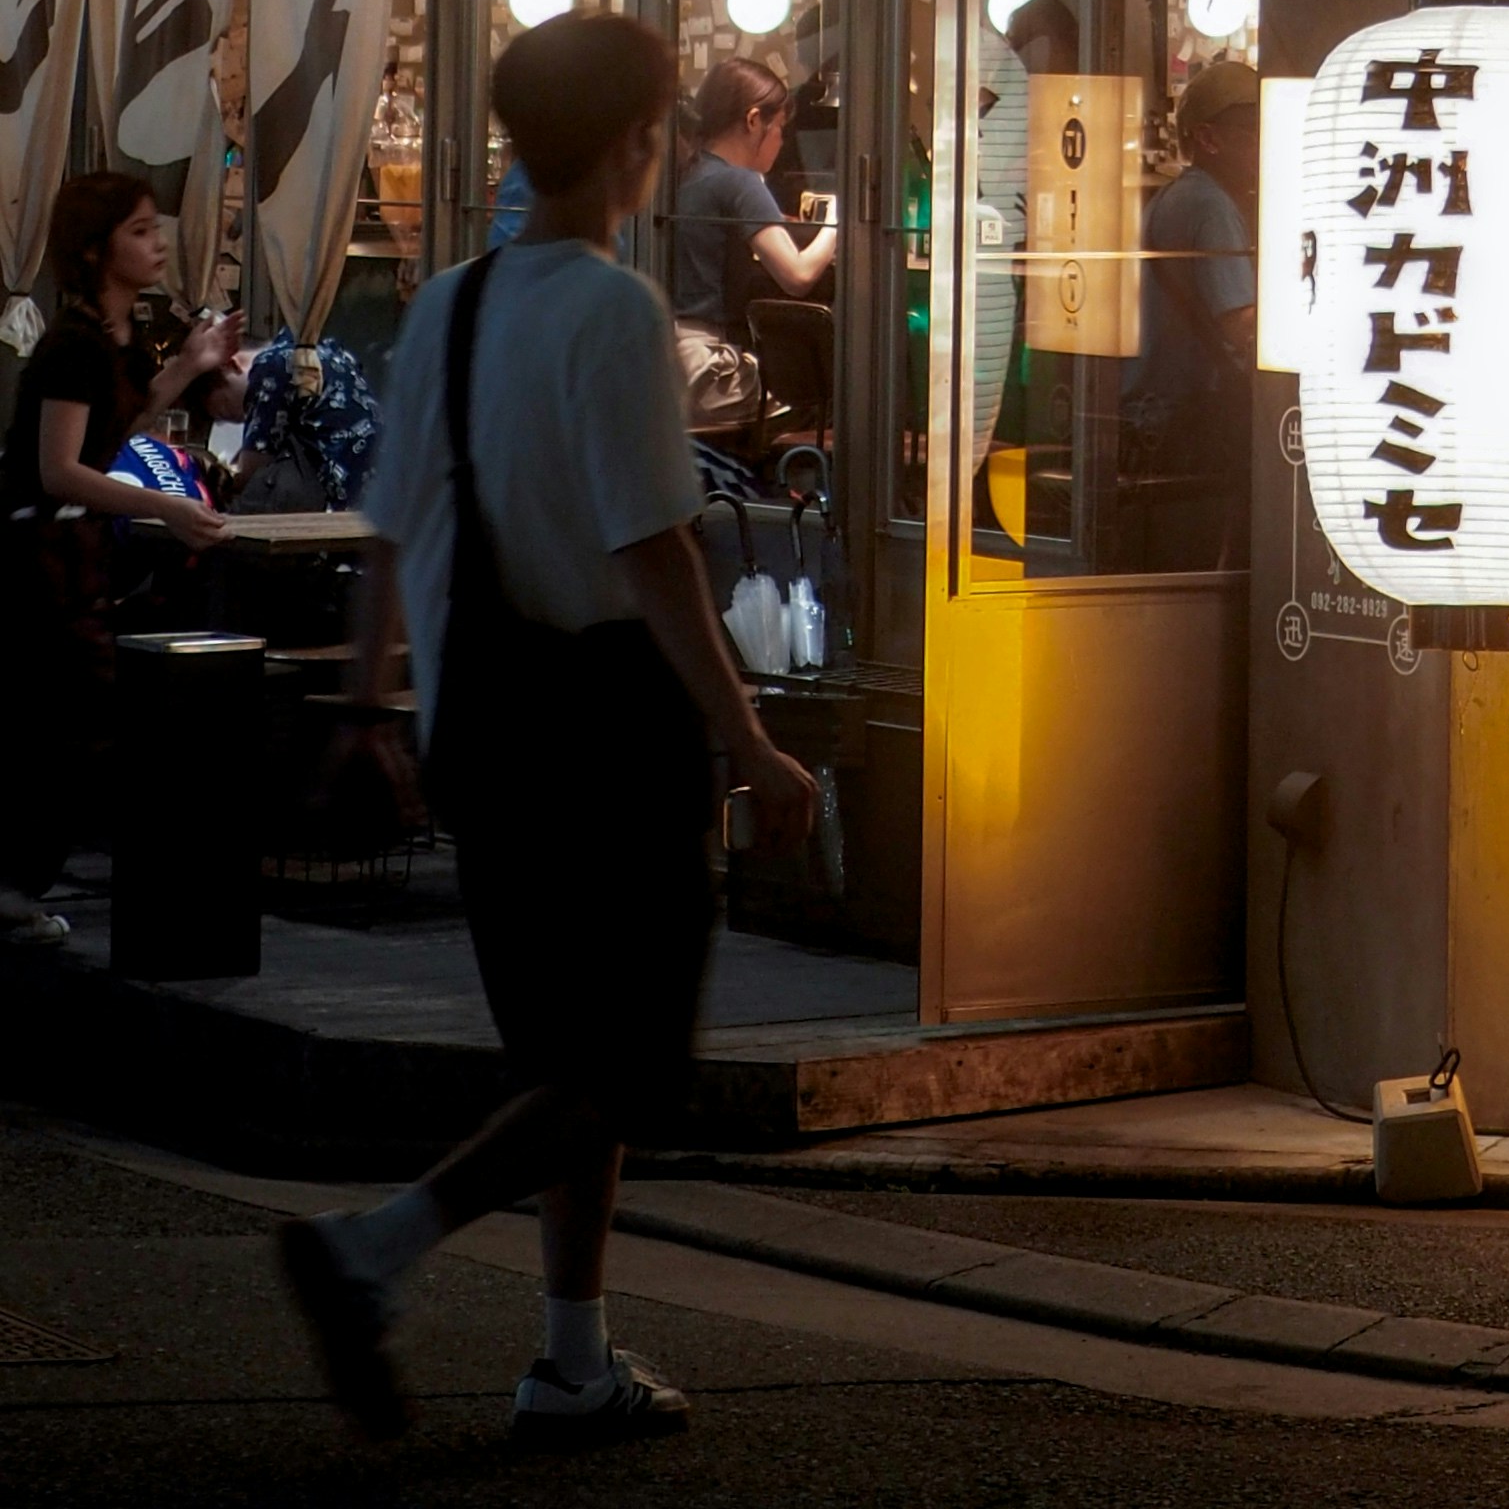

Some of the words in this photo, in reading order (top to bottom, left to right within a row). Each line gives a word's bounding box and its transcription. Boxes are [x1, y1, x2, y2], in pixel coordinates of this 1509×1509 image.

[1347, 48, 1479, 551] 中洲カドミセ
